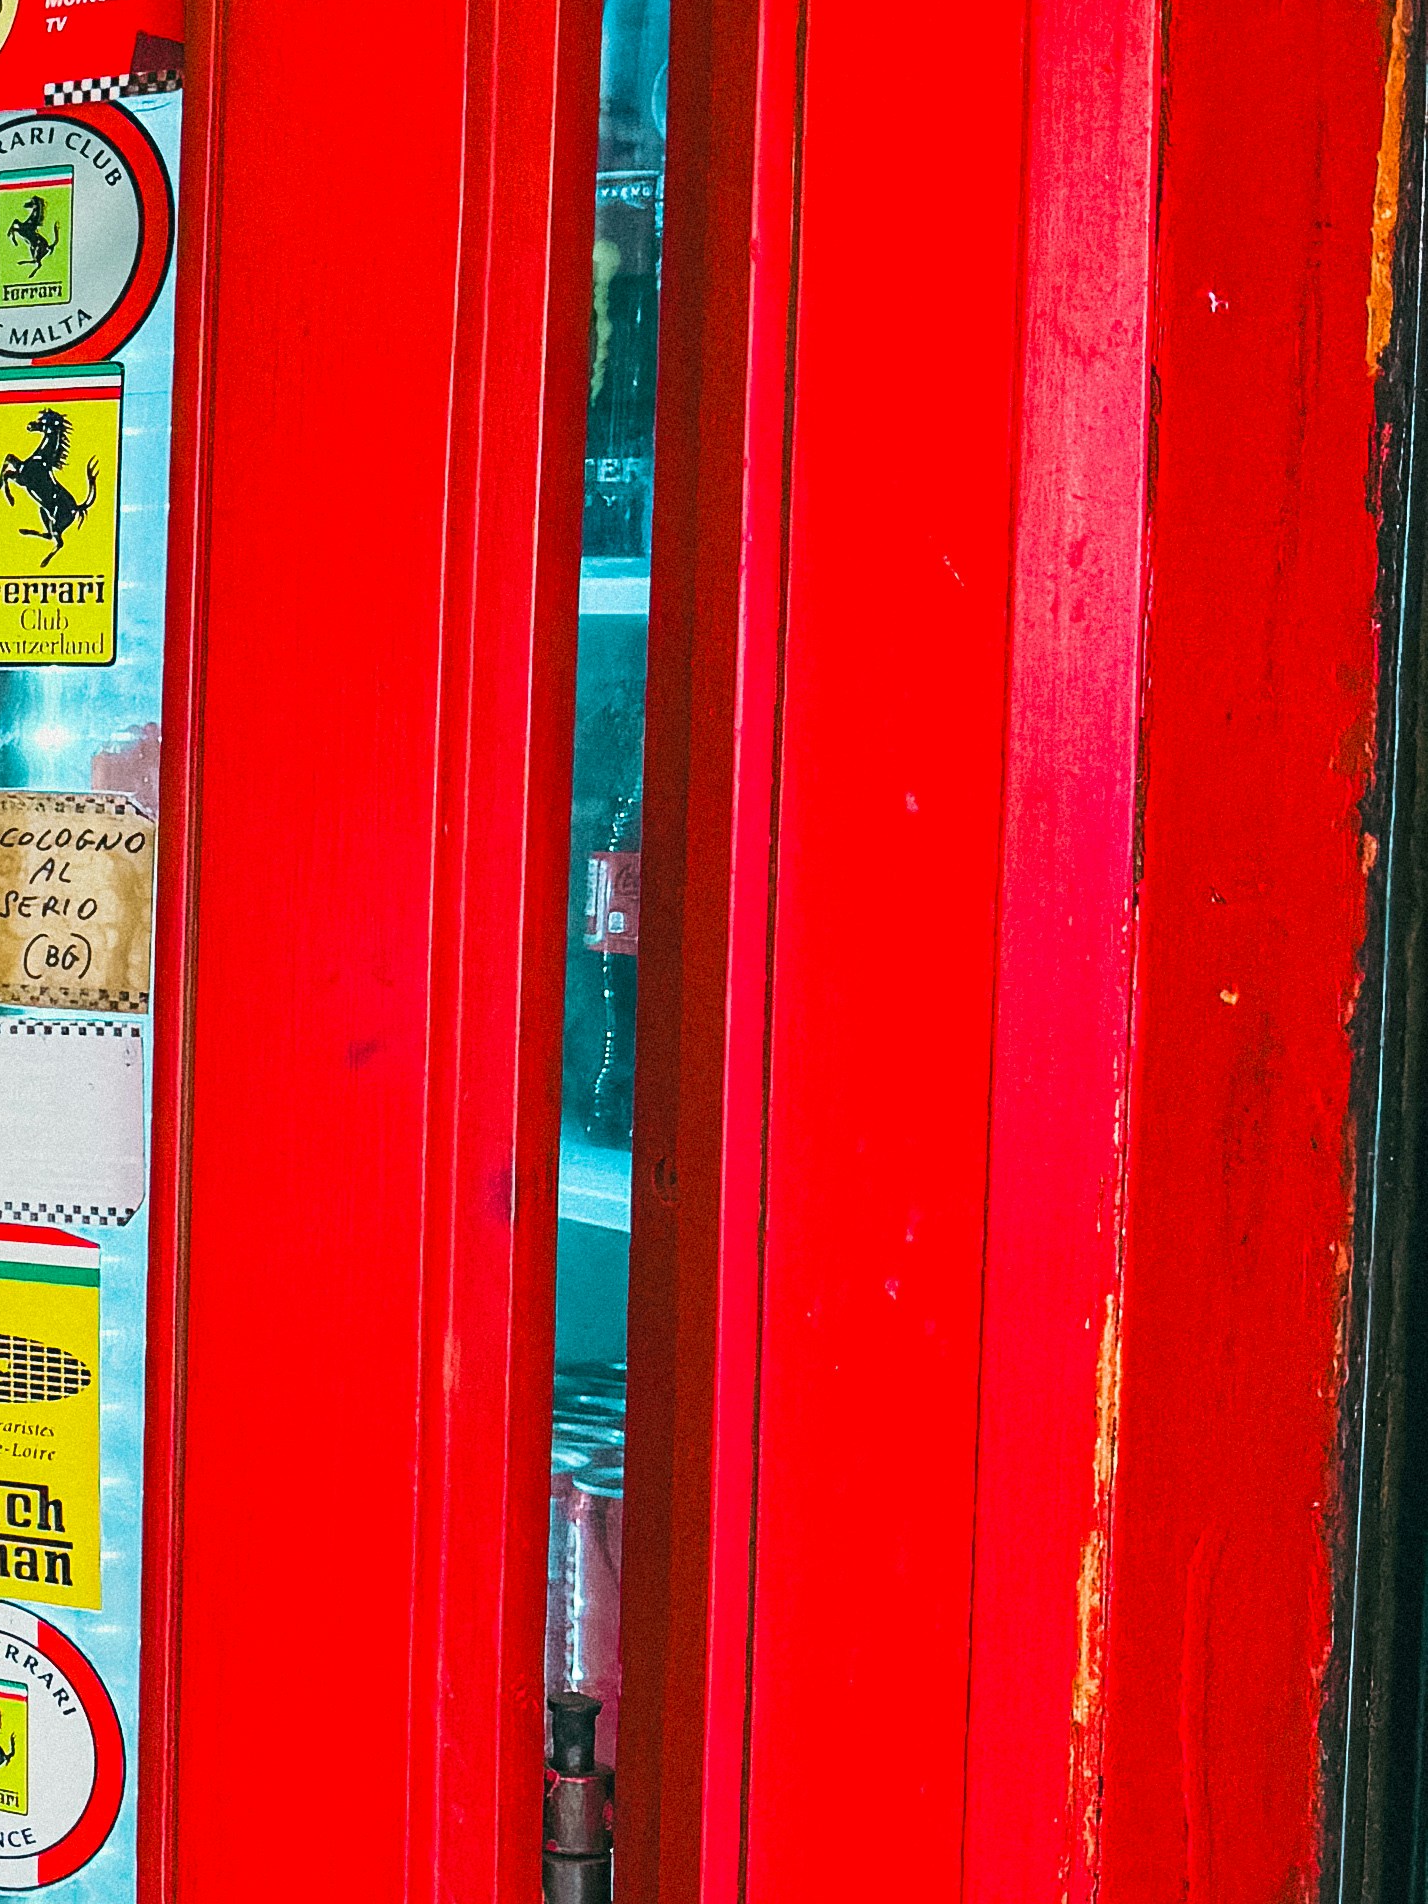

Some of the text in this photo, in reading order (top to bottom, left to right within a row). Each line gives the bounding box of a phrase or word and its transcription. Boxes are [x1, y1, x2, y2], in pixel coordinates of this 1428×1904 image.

[64, 130, 122, 188] CLUB
[8, 307, 94, 346] MALTA
[20, 608, 69, 632] Club
[0, 826, 147, 854] COLOGNO
[28, 858, 75, 885] AL
[0, 892, 99, 921] SERIO
[22, 934, 93, 980] (BG)
